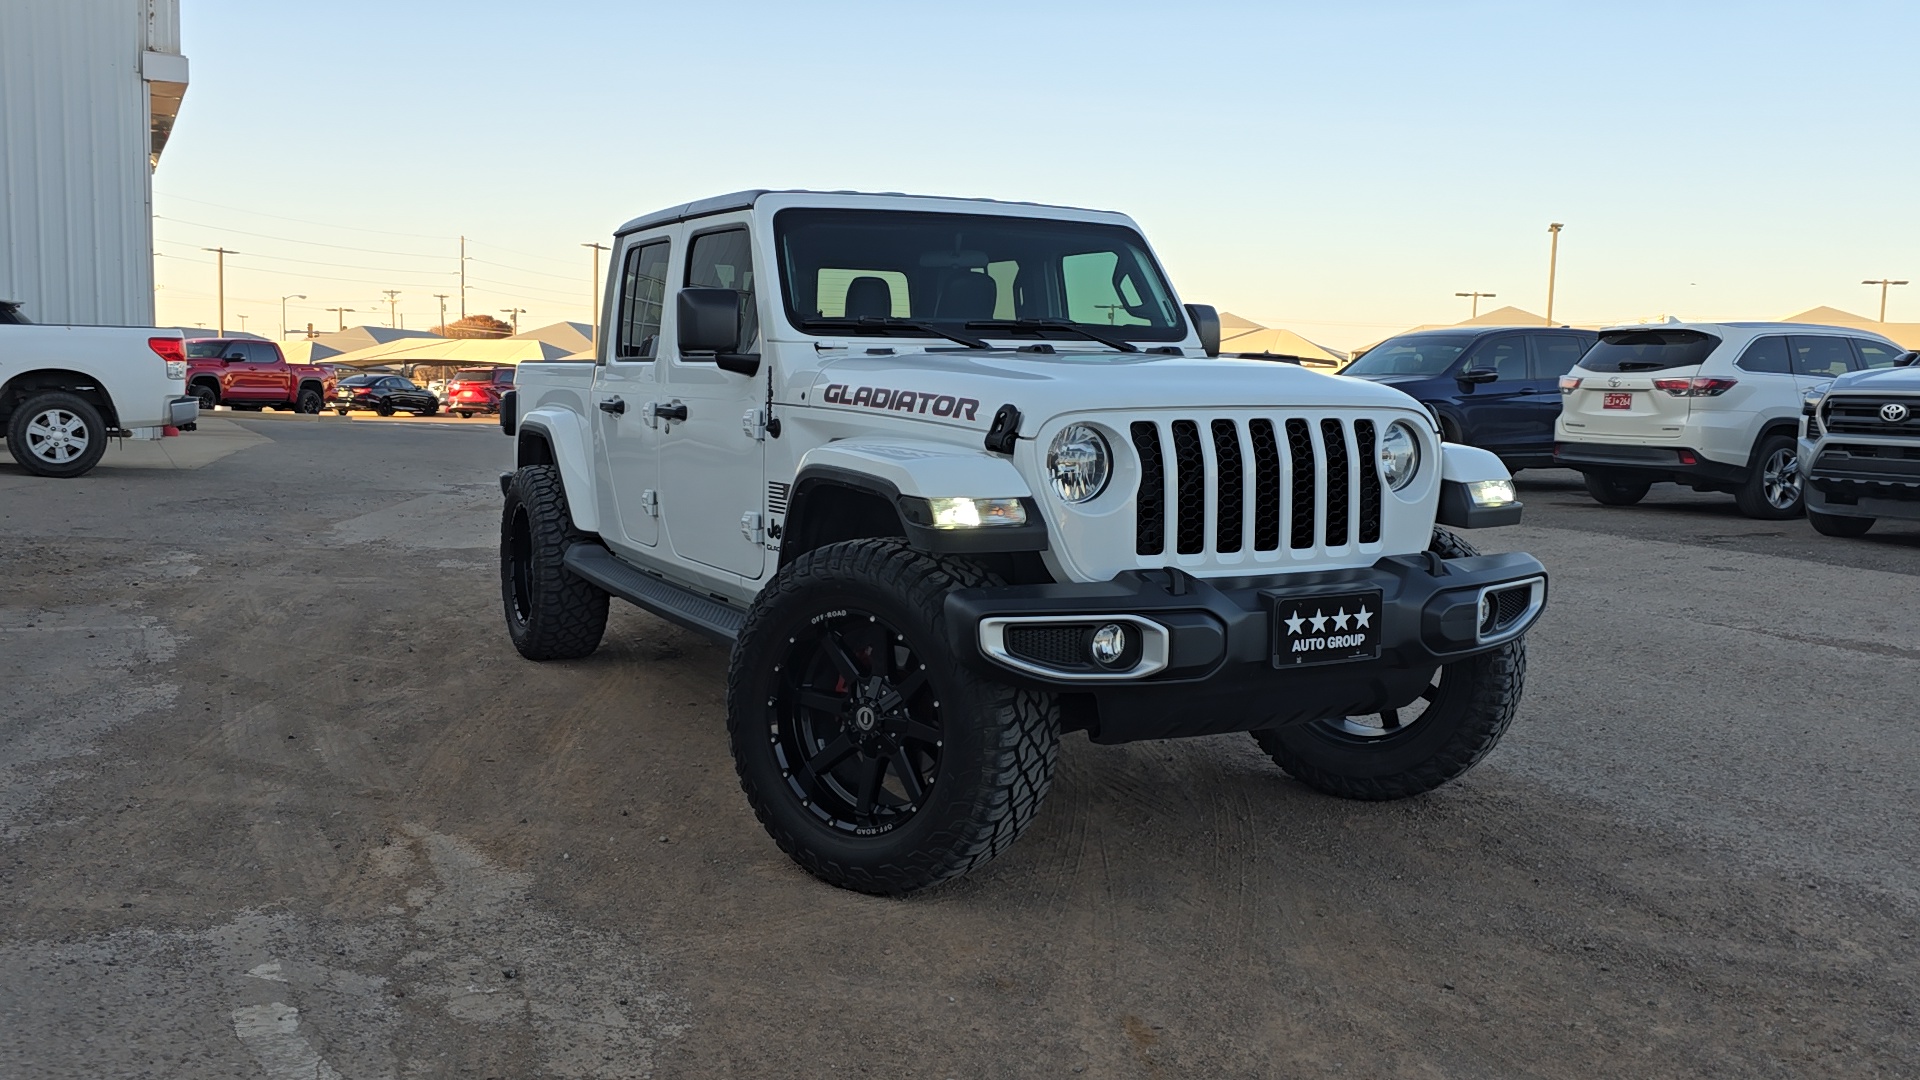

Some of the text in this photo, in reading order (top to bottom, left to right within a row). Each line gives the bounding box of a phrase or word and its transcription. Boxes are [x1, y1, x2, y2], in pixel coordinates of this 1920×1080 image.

[823, 384, 980, 422] GLADIATOR
[811, 609, 847, 625] OFF-ROAD
[1292, 634, 1366, 652] AUTO GROUP
[856, 823, 893, 835] OFF-ROAD
